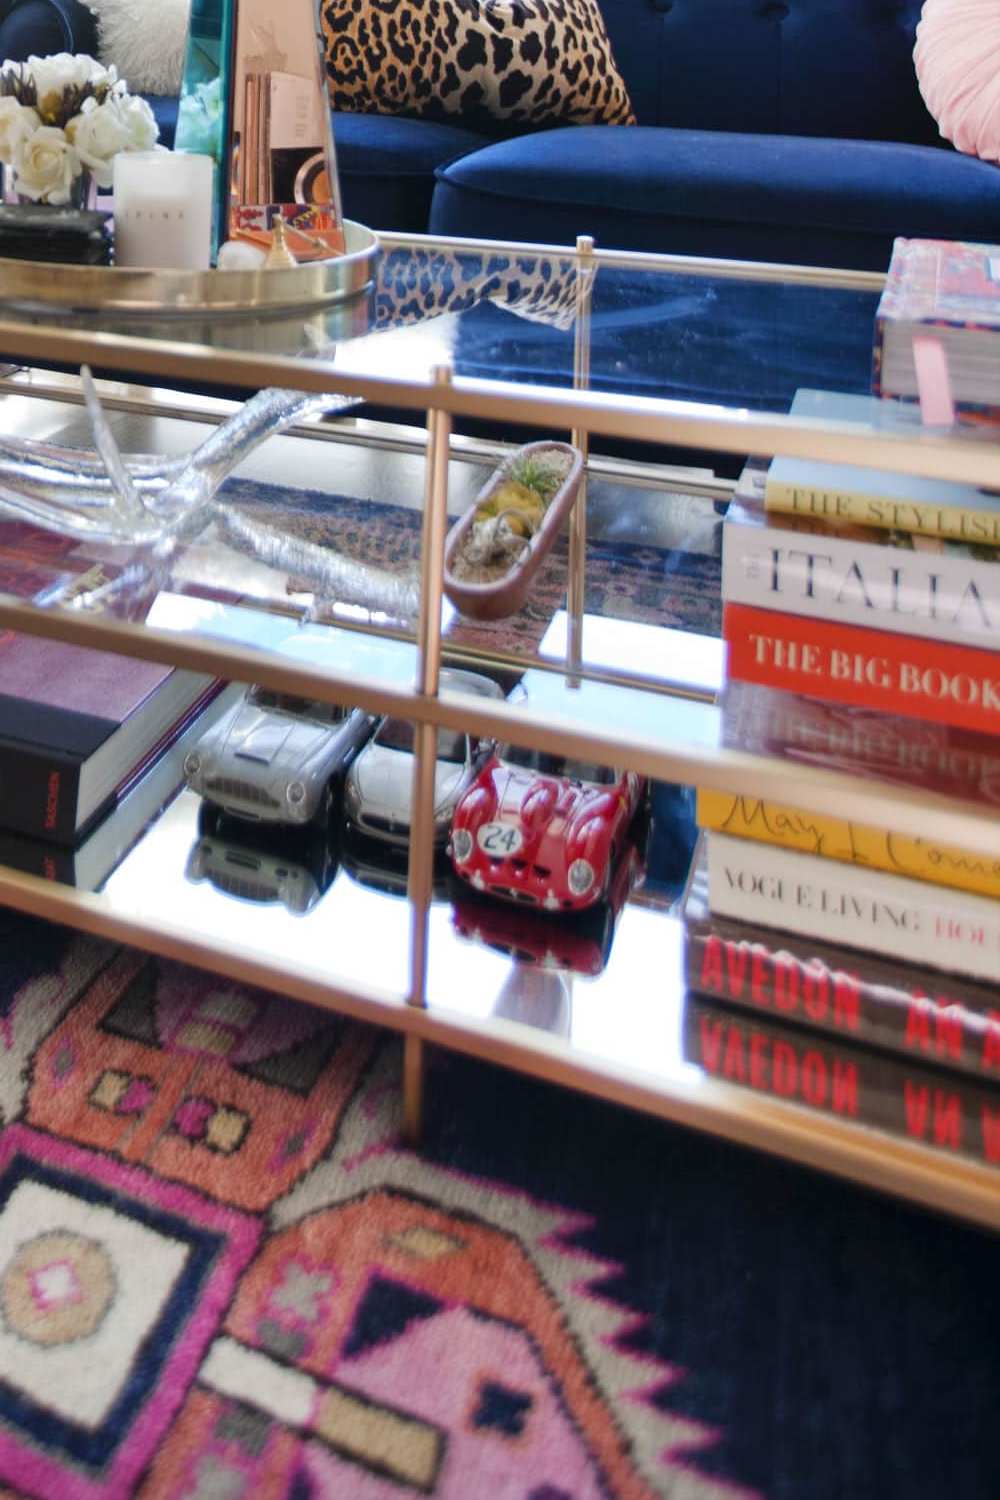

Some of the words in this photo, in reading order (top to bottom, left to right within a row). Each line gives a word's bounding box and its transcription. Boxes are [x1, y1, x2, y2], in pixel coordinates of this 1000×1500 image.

[786, 487, 851, 517] THE
[749, 634, 821, 675] THE
[830, 649, 891, 689] BIG
[900, 663, 1000, 712] BOOK
[483, 825, 516, 852] 24
[721, 795, 825, 854] May
[724, 867, 811, 908] VOGUE
[820, 888, 920, 931] LIVING
[700, 934, 860, 1030] AVEDON
[905, 988, 963, 1061] AN
